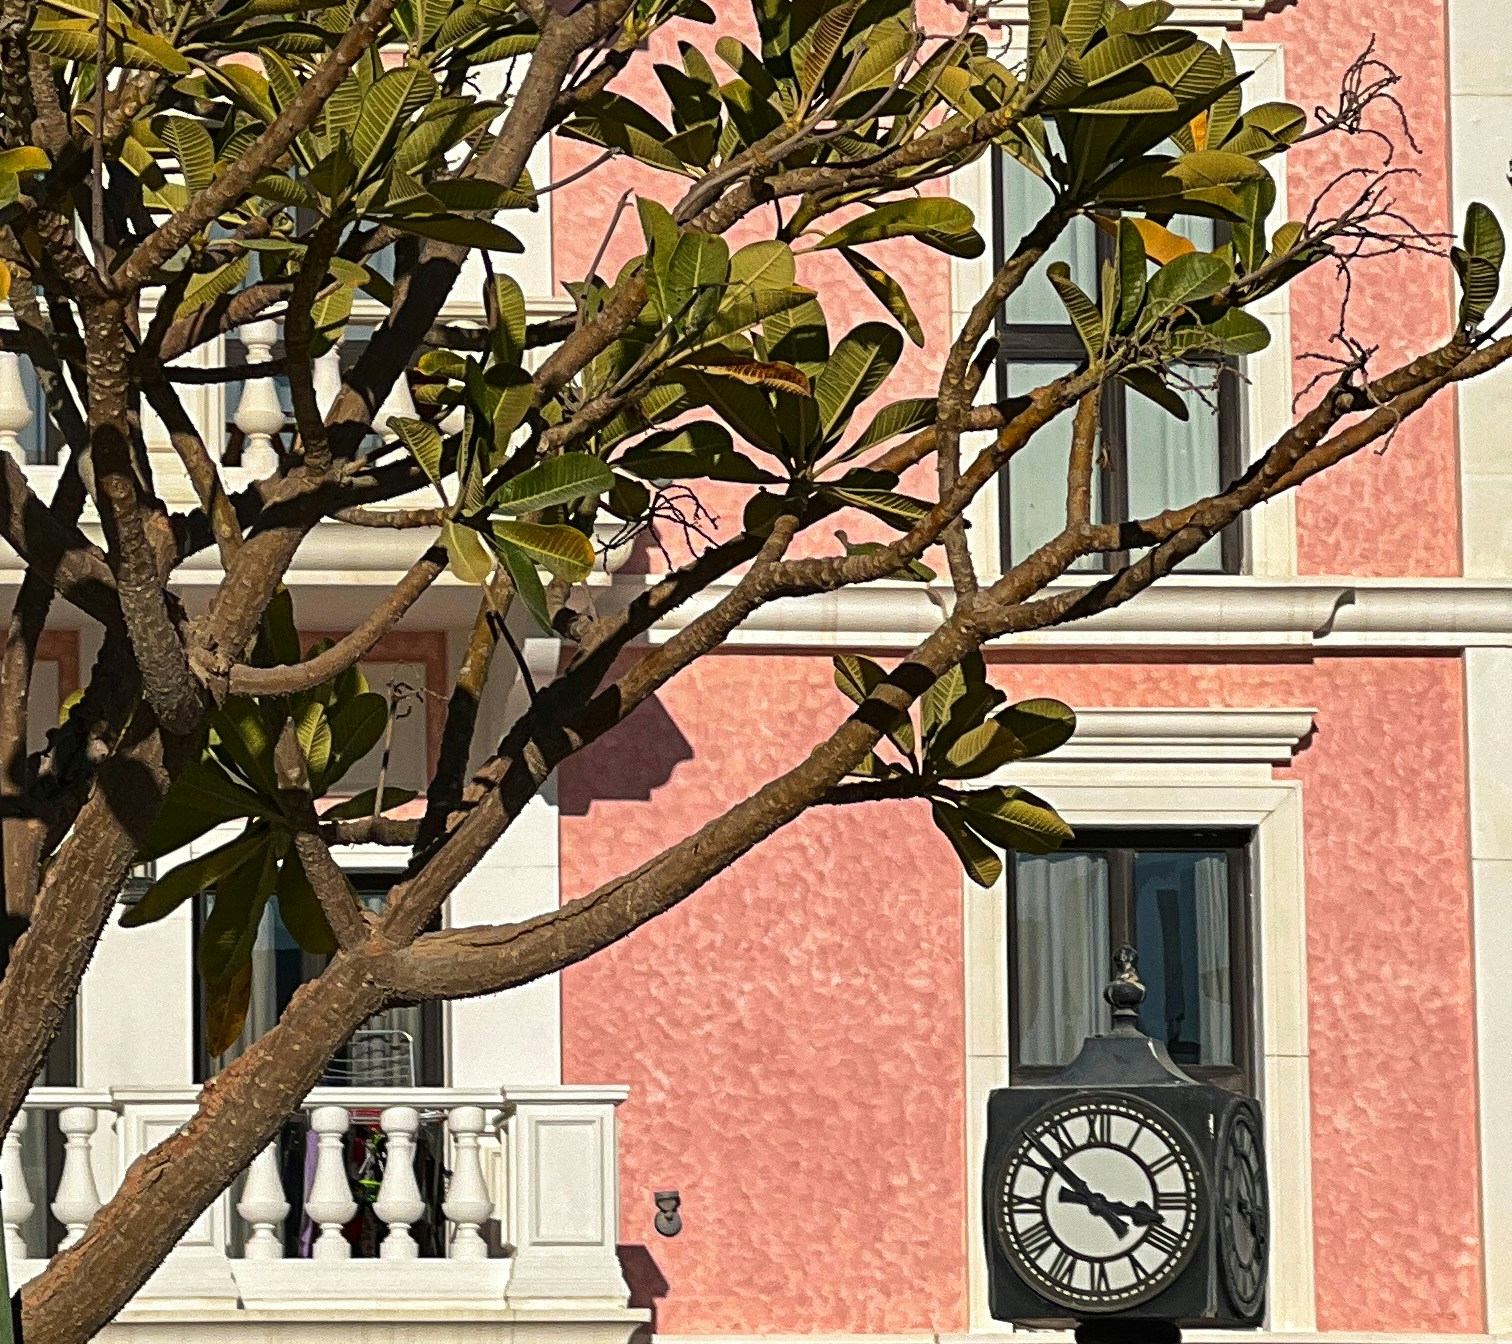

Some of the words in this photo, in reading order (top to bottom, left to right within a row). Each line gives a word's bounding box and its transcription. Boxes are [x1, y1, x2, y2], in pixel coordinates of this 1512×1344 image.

[1046, 1121, 1076, 1157] XI
[1087, 1114, 1111, 1144] XII
[1148, 1152, 1177, 1176] II
[1011, 1194, 1043, 1214] IX
[1156, 1192, 1188, 1210] III
[1090, 1261, 1110, 1292] VI
[1131, 1253, 1151, 1280] V
